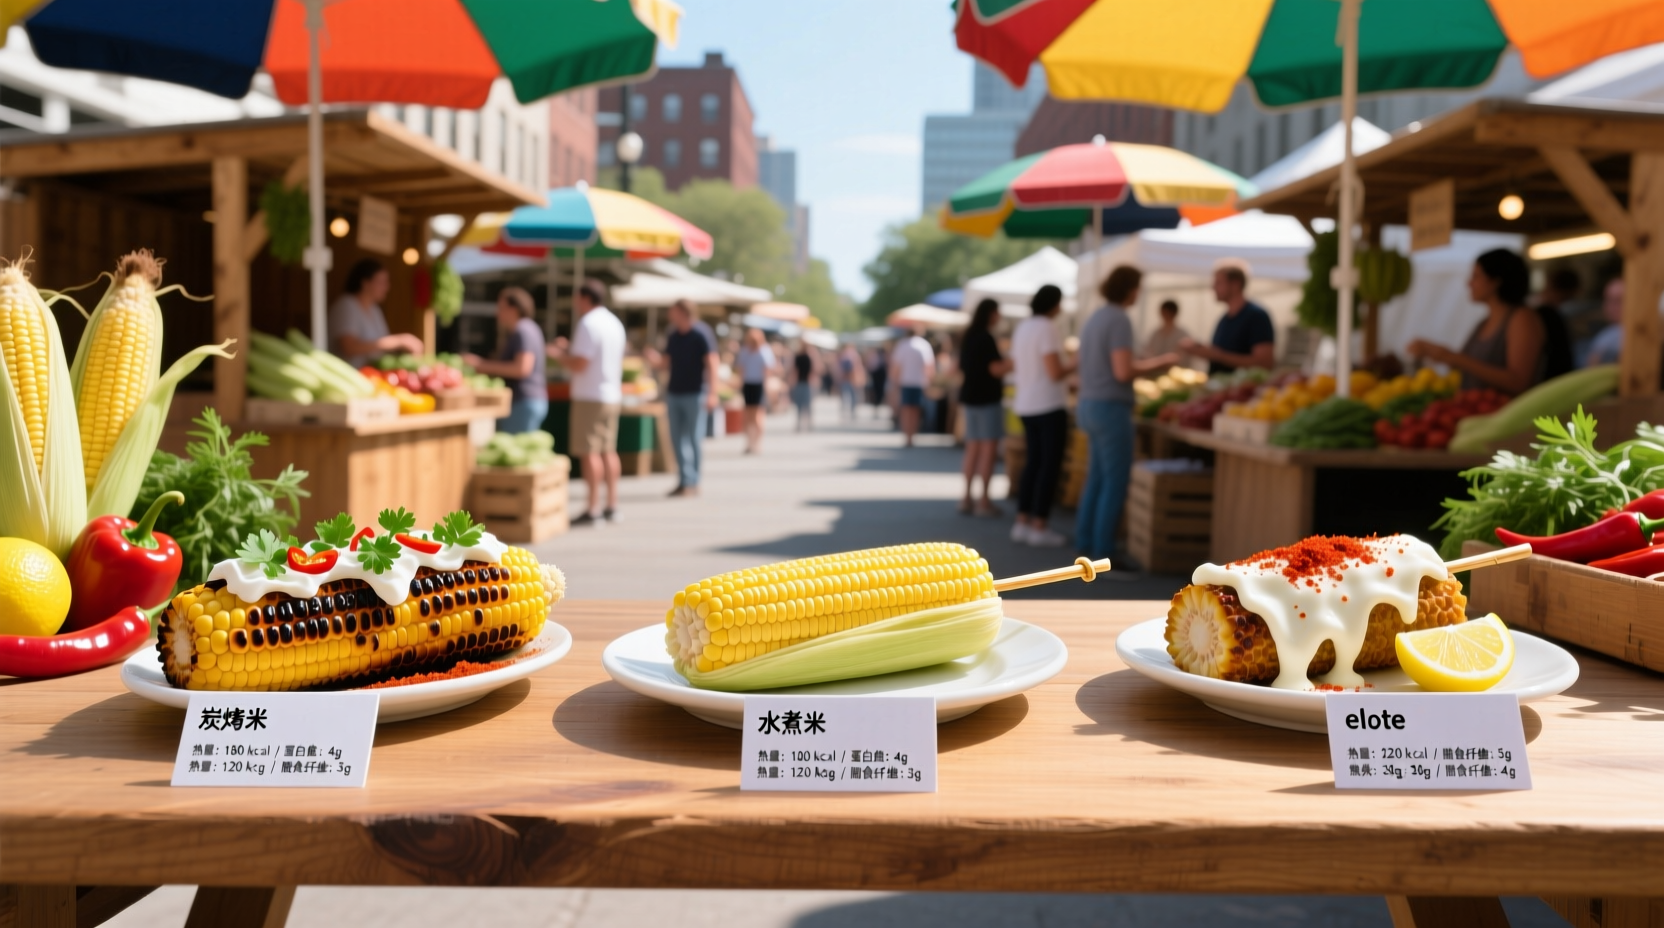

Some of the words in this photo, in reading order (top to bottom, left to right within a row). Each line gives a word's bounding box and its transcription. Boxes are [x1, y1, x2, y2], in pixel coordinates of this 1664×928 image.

[757, 709, 827, 736] 水煮米
[1345, 708, 1406, 731] elote
[328, 746, 343, 760] 4g
[894, 751, 908, 765] 4g
[1498, 747, 1512, 762] 5g
[223, 761, 243, 772] 120
[791, 766, 812, 778] 120
[1500, 765, 1517, 780] 4g
